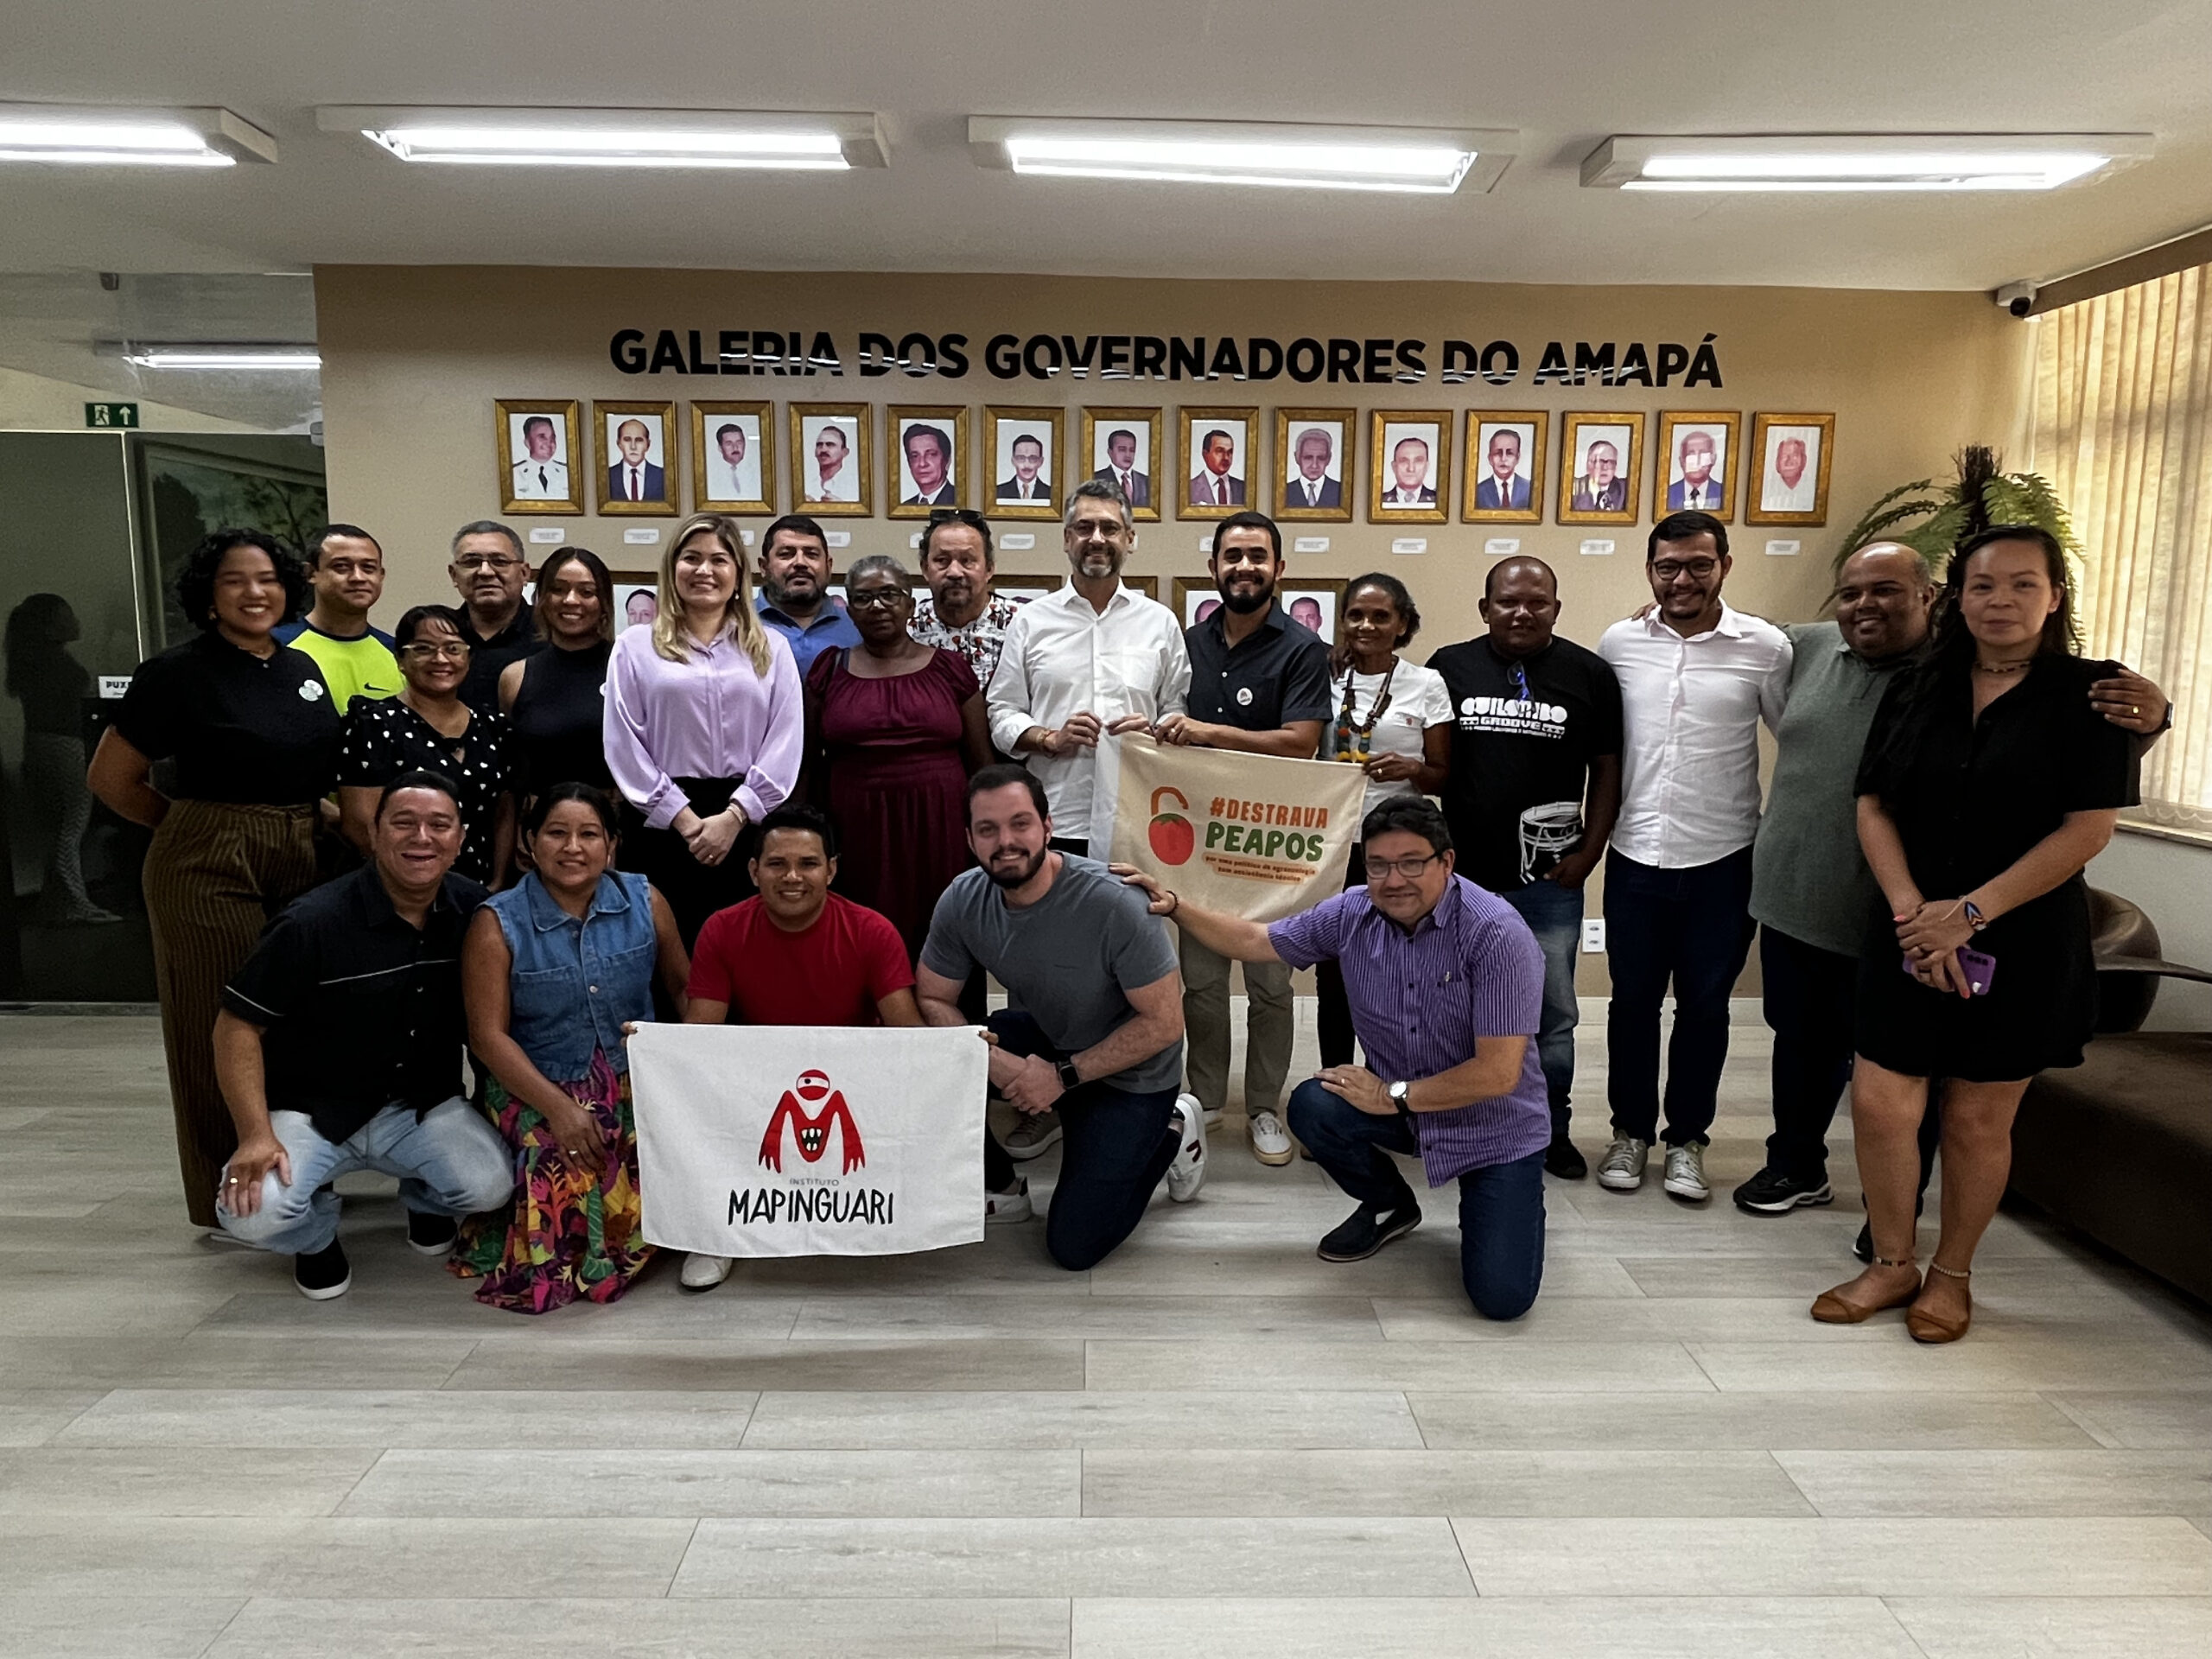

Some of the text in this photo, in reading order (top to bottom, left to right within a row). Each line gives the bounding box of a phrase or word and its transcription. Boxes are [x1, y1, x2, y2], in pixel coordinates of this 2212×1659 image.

[610, 327, 1724, 388] GALERIA DOS GOVERNADORES DO AMAPÁ
[1480, 716, 1541, 730] GROOVE
[1210, 797, 1329, 829] #DESTRAVA
[1205, 821, 1325, 862] PEAPOS
[790, 1178, 840, 1186] INSTITUTO
[728, 1188, 894, 1226] MAPINGUARI
